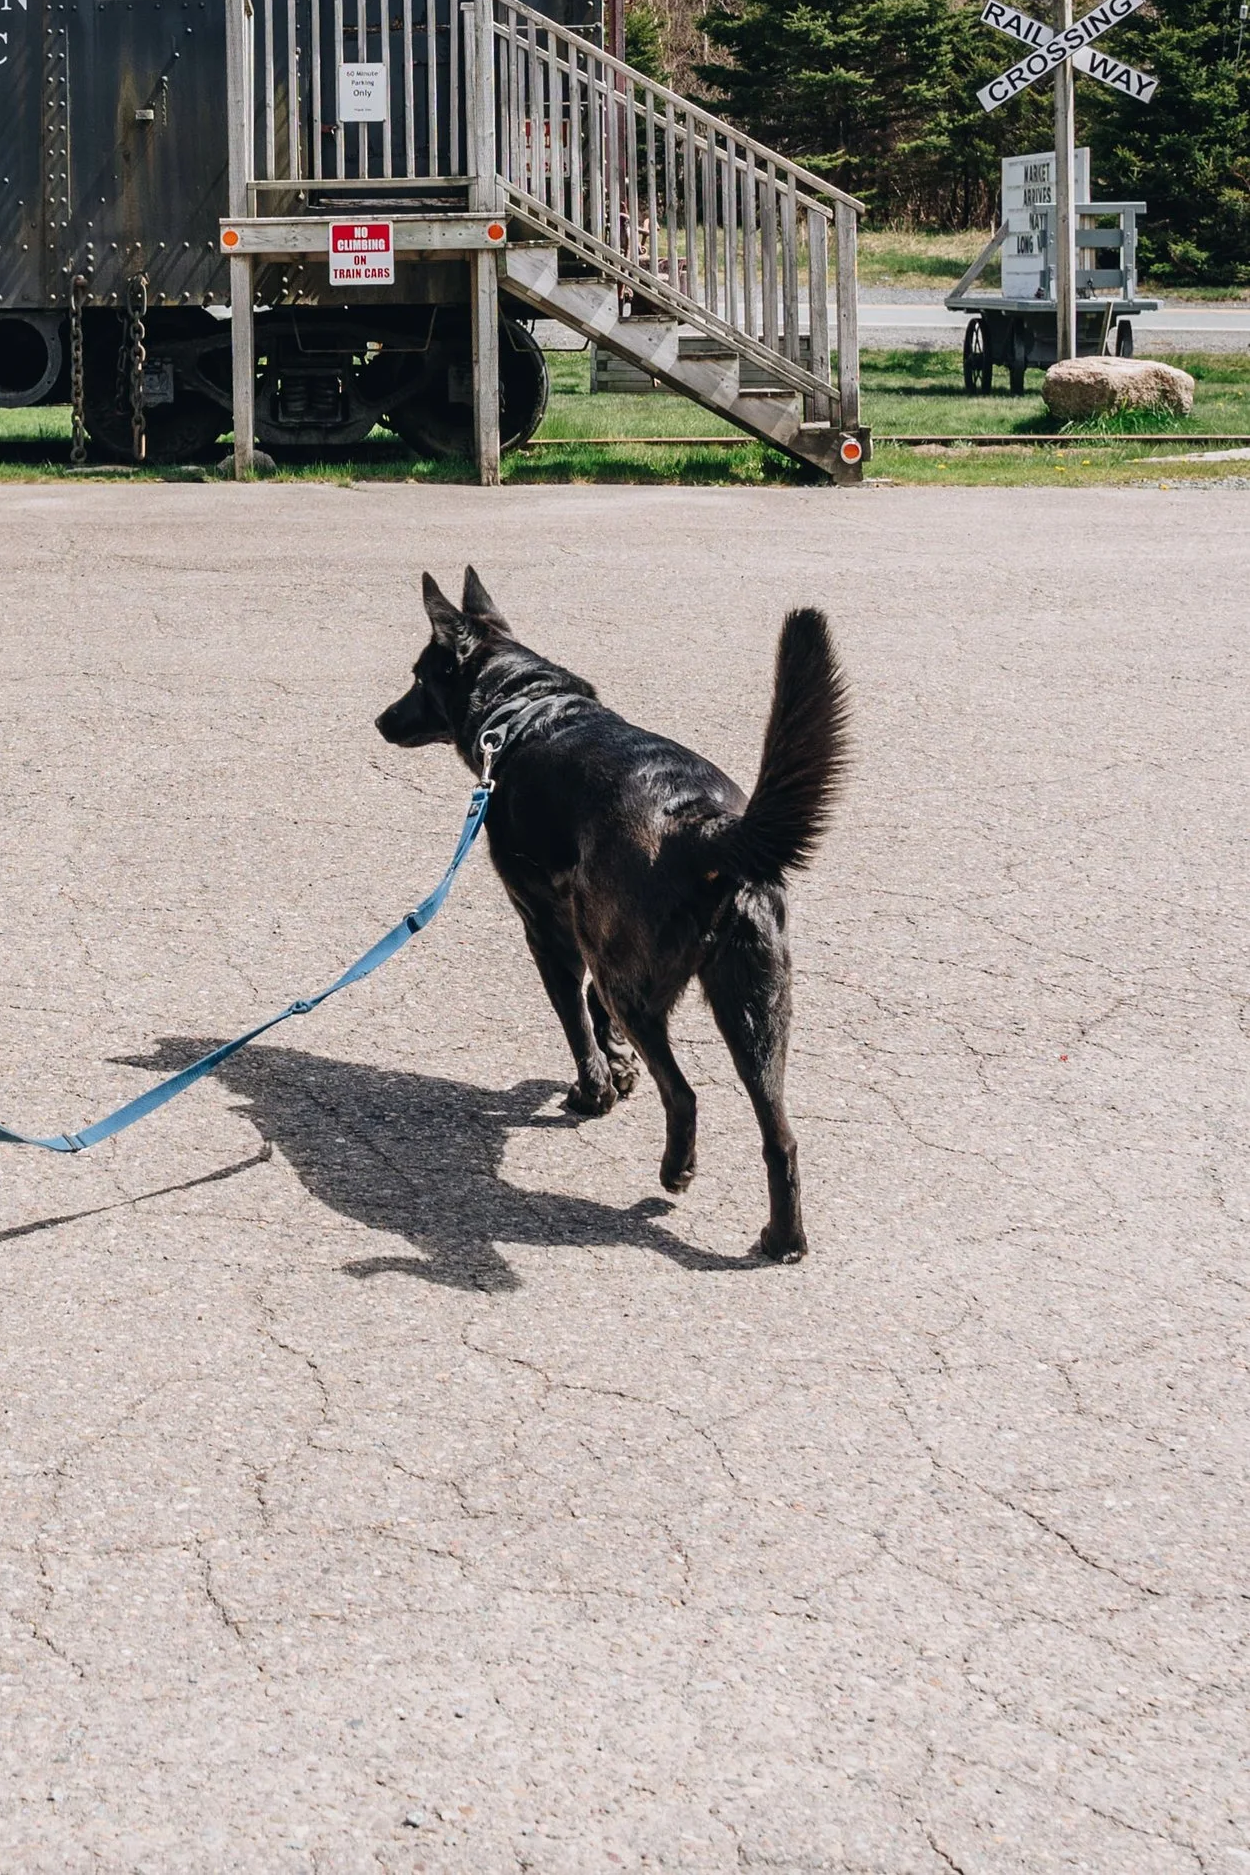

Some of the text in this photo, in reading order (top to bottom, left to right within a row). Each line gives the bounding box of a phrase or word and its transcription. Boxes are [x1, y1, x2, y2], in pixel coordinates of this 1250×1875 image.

[983, 2, 1155, 97] RAIL WAY
[353, 89, 372, 98] Only
[1023, 162, 1050, 184] MARKET
[1023, 186, 1052, 207] ARRIVES
[354, 226, 368, 238] NO
[337, 238, 386, 251] CLIMBING
[1017, 235, 1034, 254] LONG
[354, 255, 367, 266] ON
[333, 267, 390, 279] TRAIN CARS
